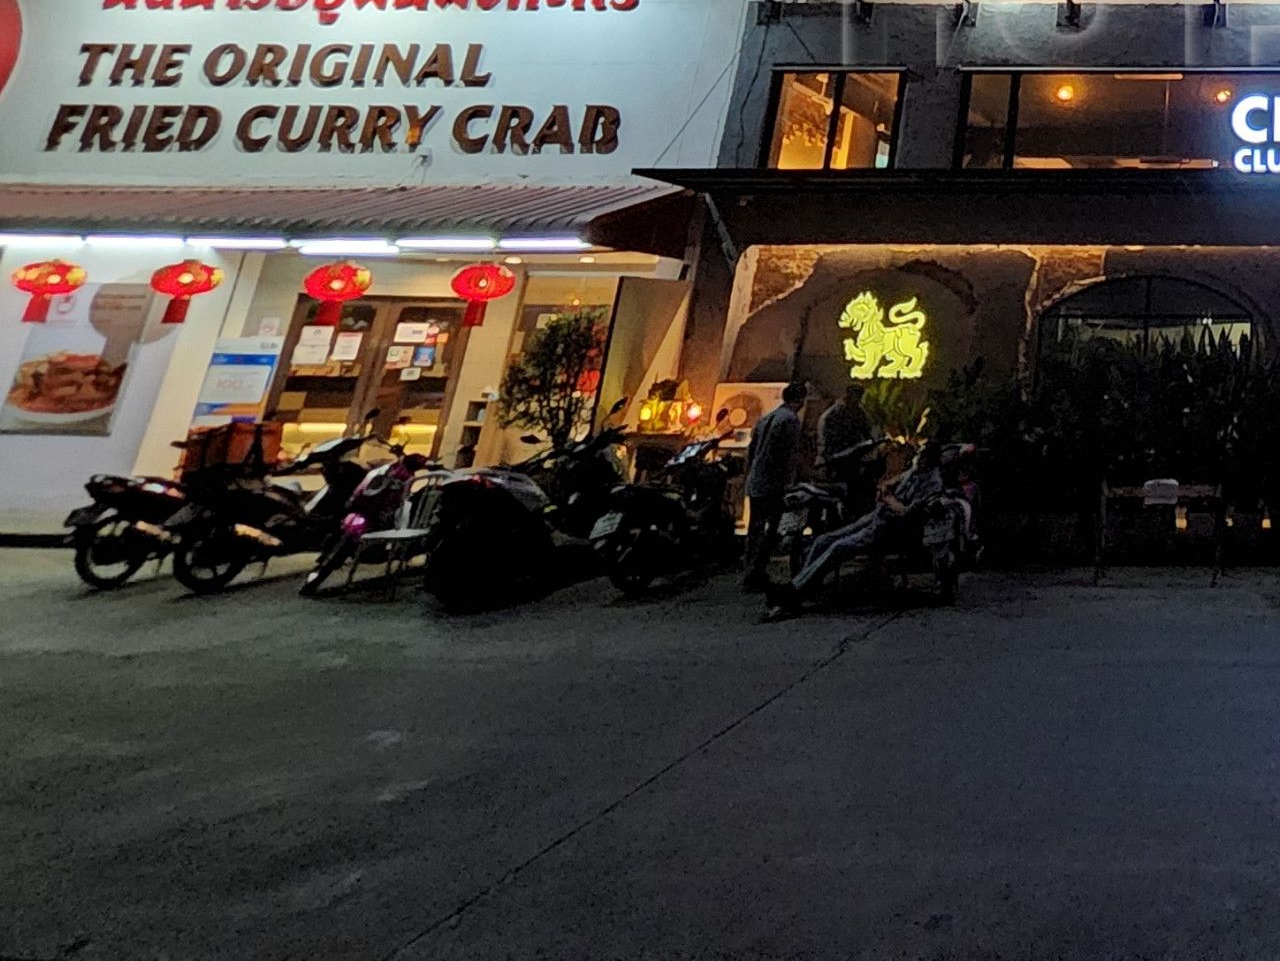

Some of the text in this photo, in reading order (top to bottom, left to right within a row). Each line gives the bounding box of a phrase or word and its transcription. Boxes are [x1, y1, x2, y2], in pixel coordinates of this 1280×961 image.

[76, 41, 493, 89] THE ORIGINAL
[43, 102, 623, 156] FRIED CURRY CRAB
